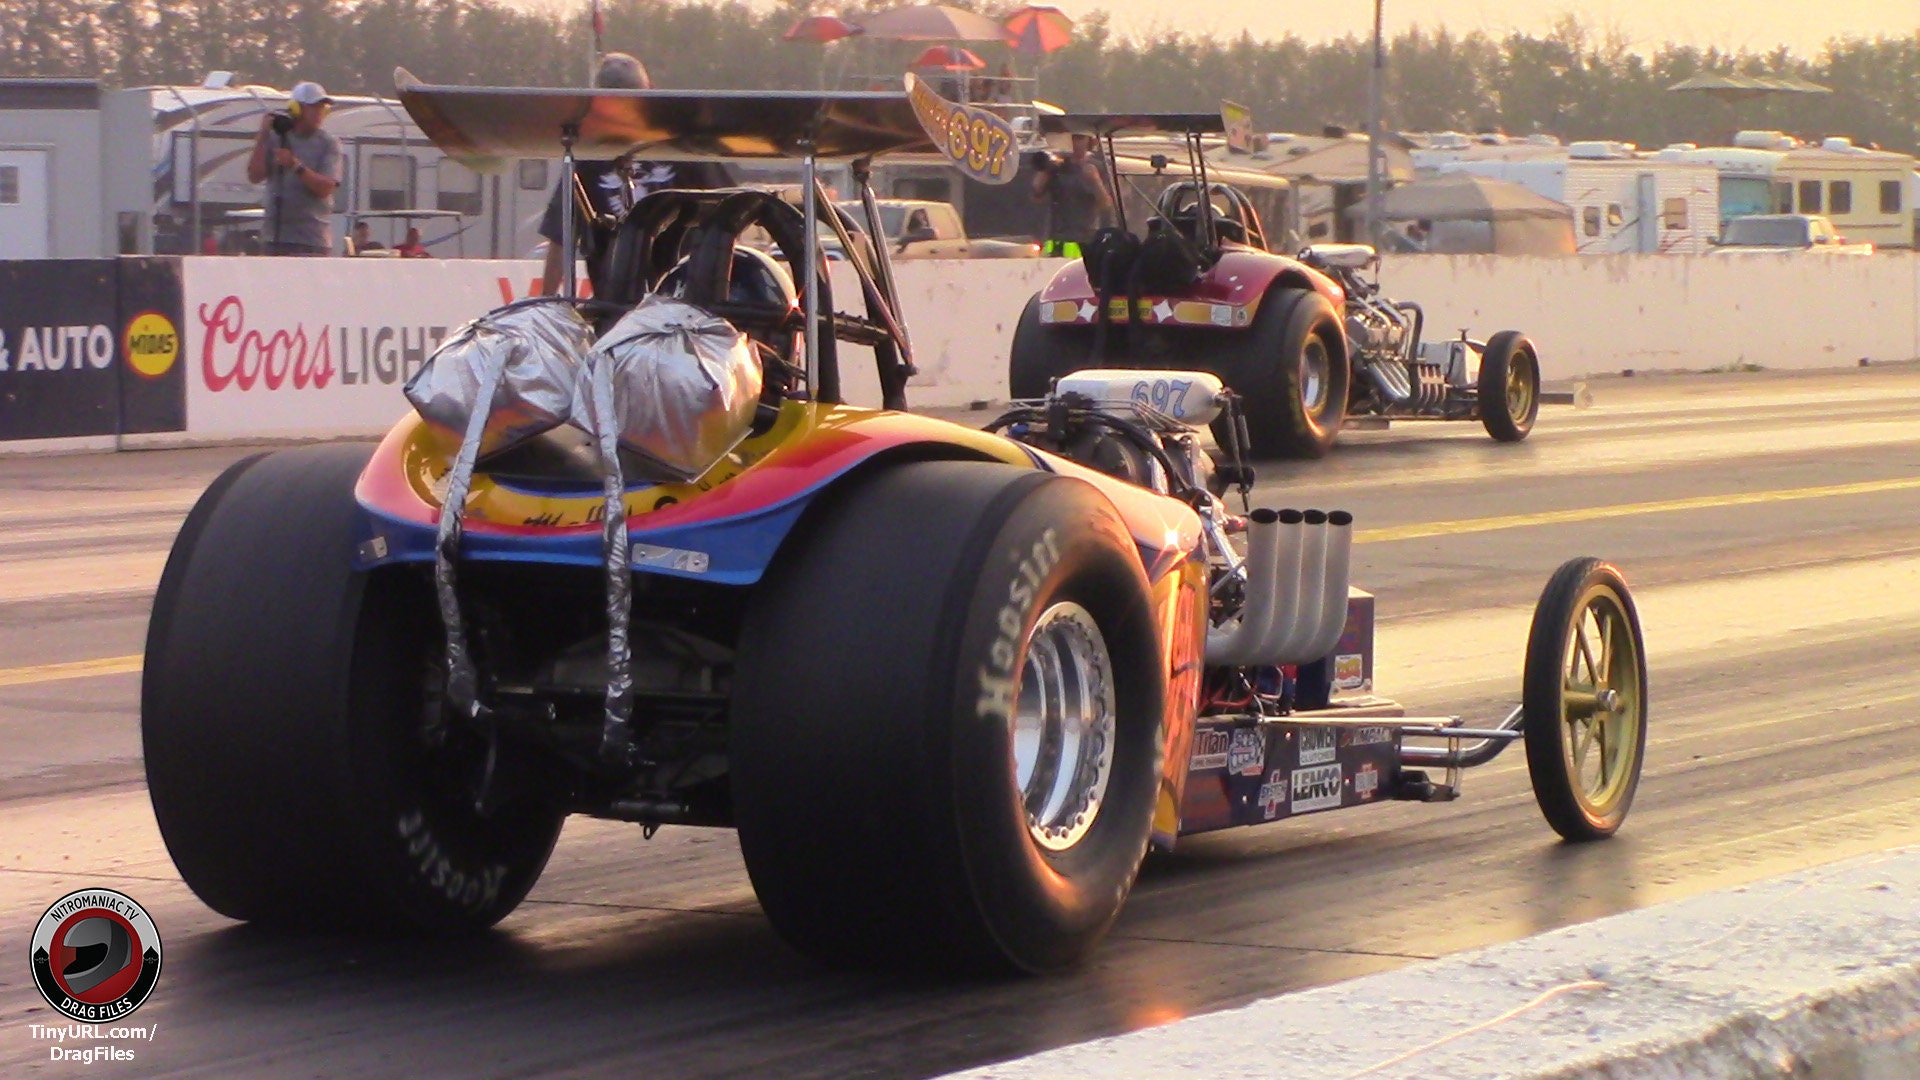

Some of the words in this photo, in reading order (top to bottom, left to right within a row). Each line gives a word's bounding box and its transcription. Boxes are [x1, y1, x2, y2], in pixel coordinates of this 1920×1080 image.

[948, 108, 1011, 177] 697
[16, 324, 114, 372] AUTO
[199, 295, 335, 392] Coors
[1130, 379, 1193, 418] 697
[1293, 768, 1340, 800] LENCO
